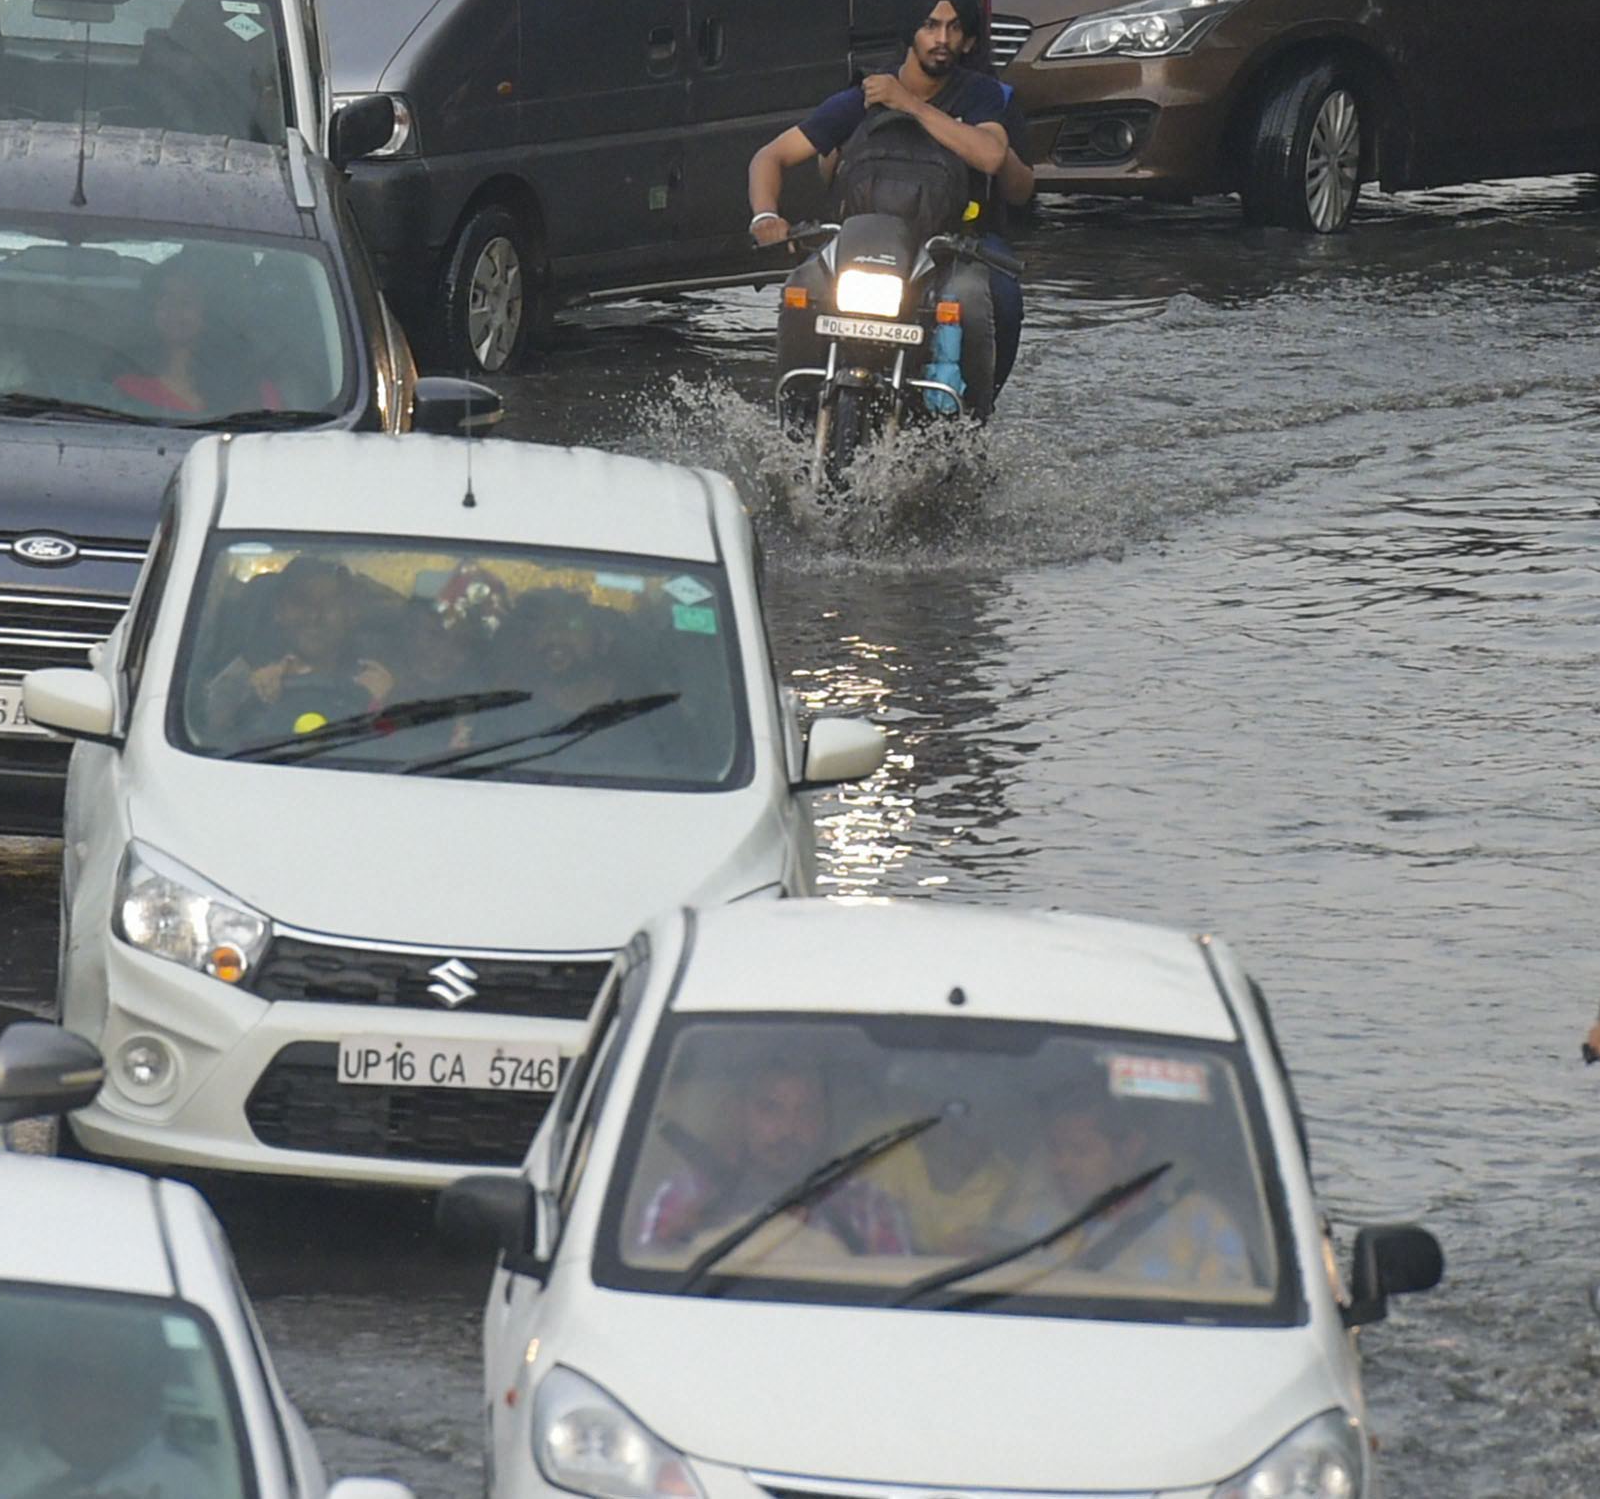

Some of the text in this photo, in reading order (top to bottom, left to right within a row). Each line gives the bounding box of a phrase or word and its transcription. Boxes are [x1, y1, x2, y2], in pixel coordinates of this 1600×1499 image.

[27, 539, 63, 557] Ford
[428, 1053, 466, 1084] CA
[488, 1055, 555, 1089] 5746
